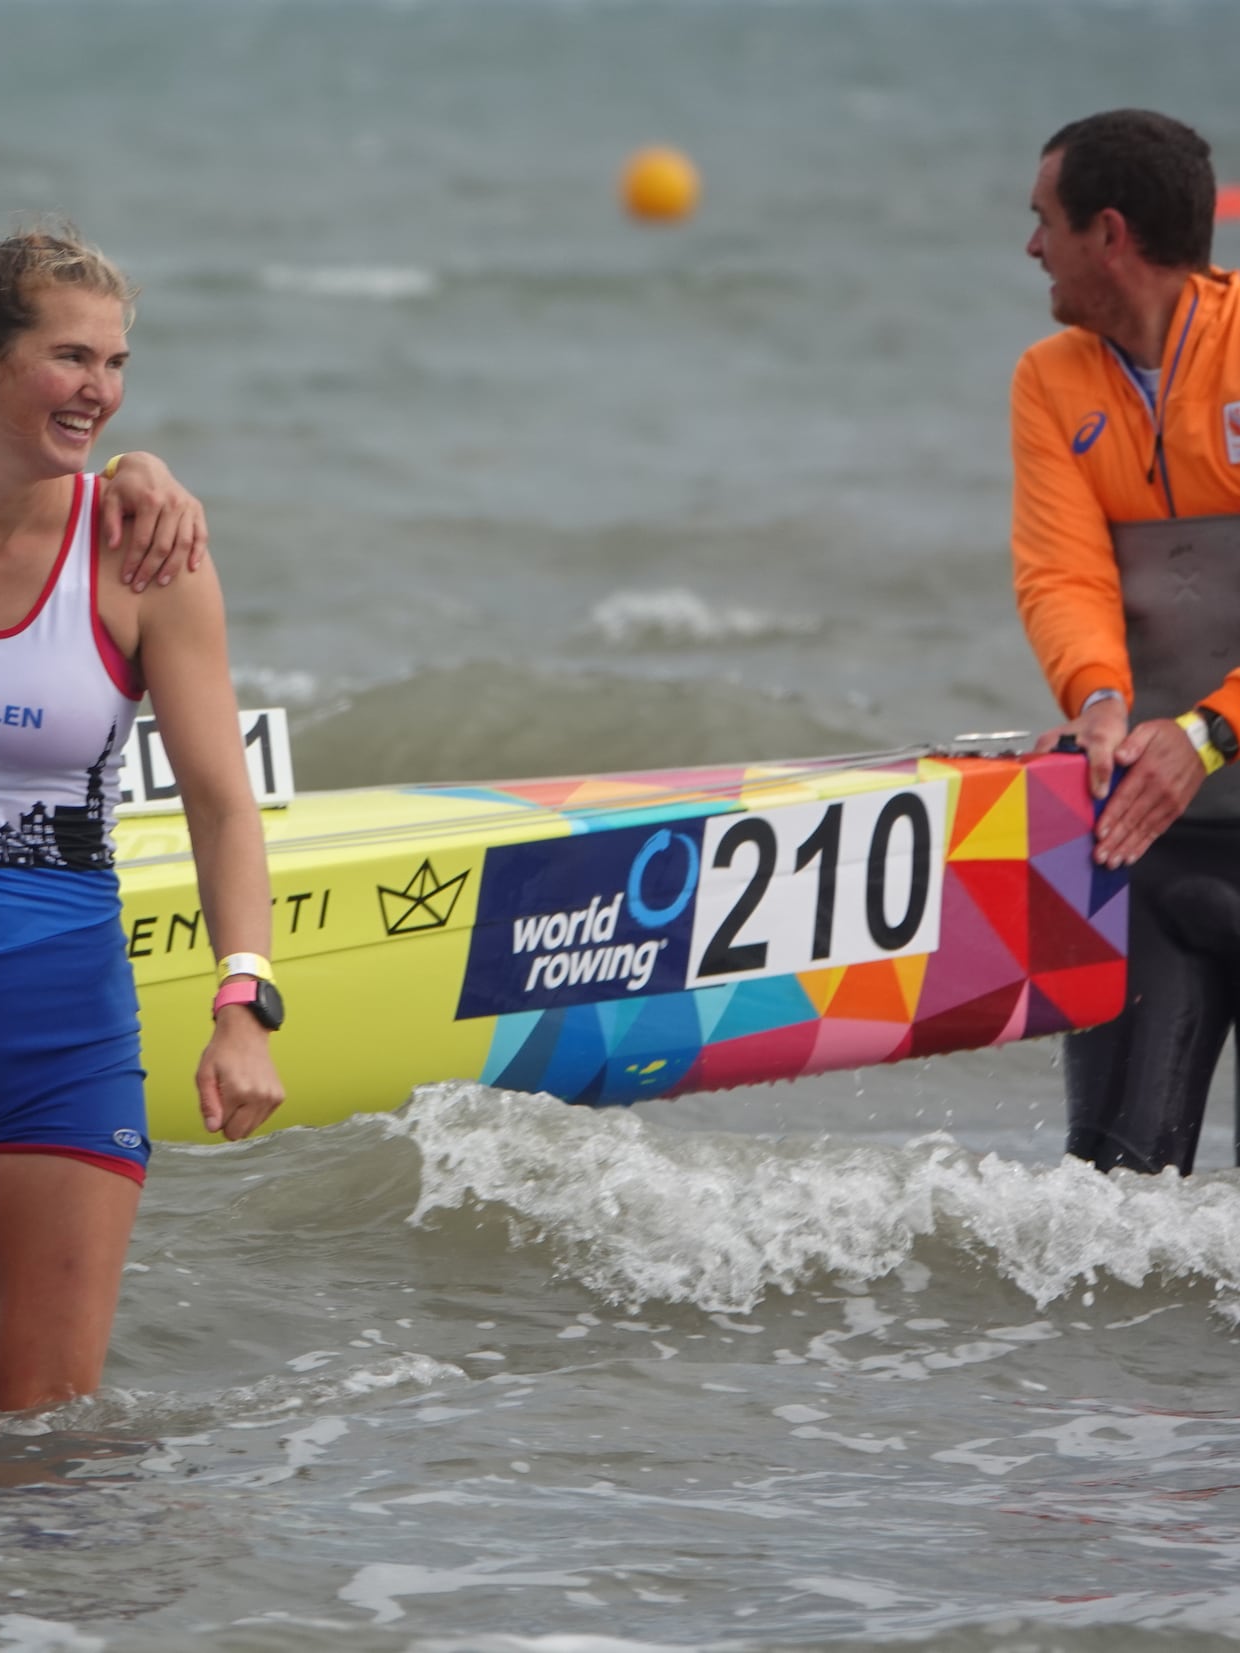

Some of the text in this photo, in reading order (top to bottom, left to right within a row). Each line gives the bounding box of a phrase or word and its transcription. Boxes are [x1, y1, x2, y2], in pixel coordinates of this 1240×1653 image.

[695, 791, 932, 980] 210
[512, 891, 626, 955] world
[523, 939, 661, 993] rowing
